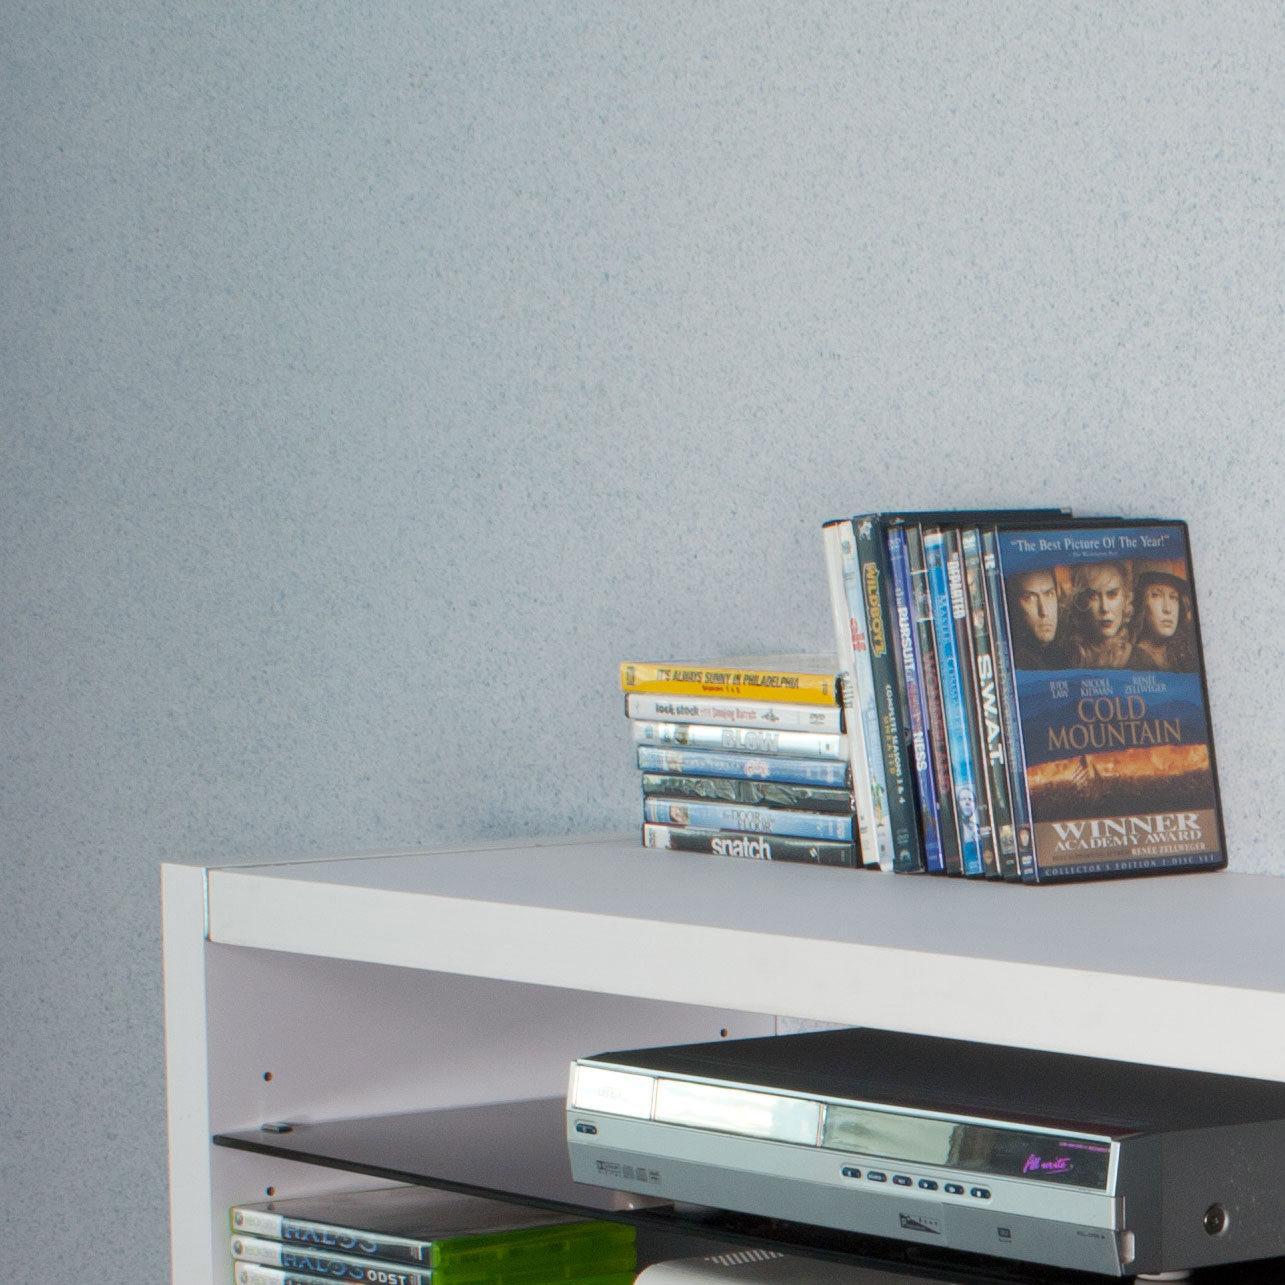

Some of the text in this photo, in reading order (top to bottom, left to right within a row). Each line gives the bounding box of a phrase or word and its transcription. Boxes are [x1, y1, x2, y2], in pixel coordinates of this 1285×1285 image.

[1039, 538, 1061, 551] Best
[1064, 537, 1100, 550] Picture
[1102, 536, 1115, 549] Of
[1119, 536, 1137, 548] The
[947, 560, 966, 619] DEPARTED
[863, 562, 887, 658] WILDBOYZ
[850, 617, 867, 652] elf
[897, 606, 916, 671] PURSUIT
[672, 669, 703, 684] ALWAYS
[704, 671, 731, 686] SUNNY
[732, 673, 741, 686] IN
[742, 673, 799, 689] PHILADELPHIA
[977, 654, 1004, 766] S.W.A.T.
[1077, 696, 1146, 723] COLD
[1048, 718, 1181, 750] MOUNTAIN
[1052, 813, 1201, 842] WINNER
[1055, 829, 1202, 852] ACADEMY AWARD
[711, 836, 772, 860] snatch
[1115, 860, 1156, 871] EDITION
[285, 1222, 357, 1249] HALO
[284, 1252, 346, 1276] HALO
